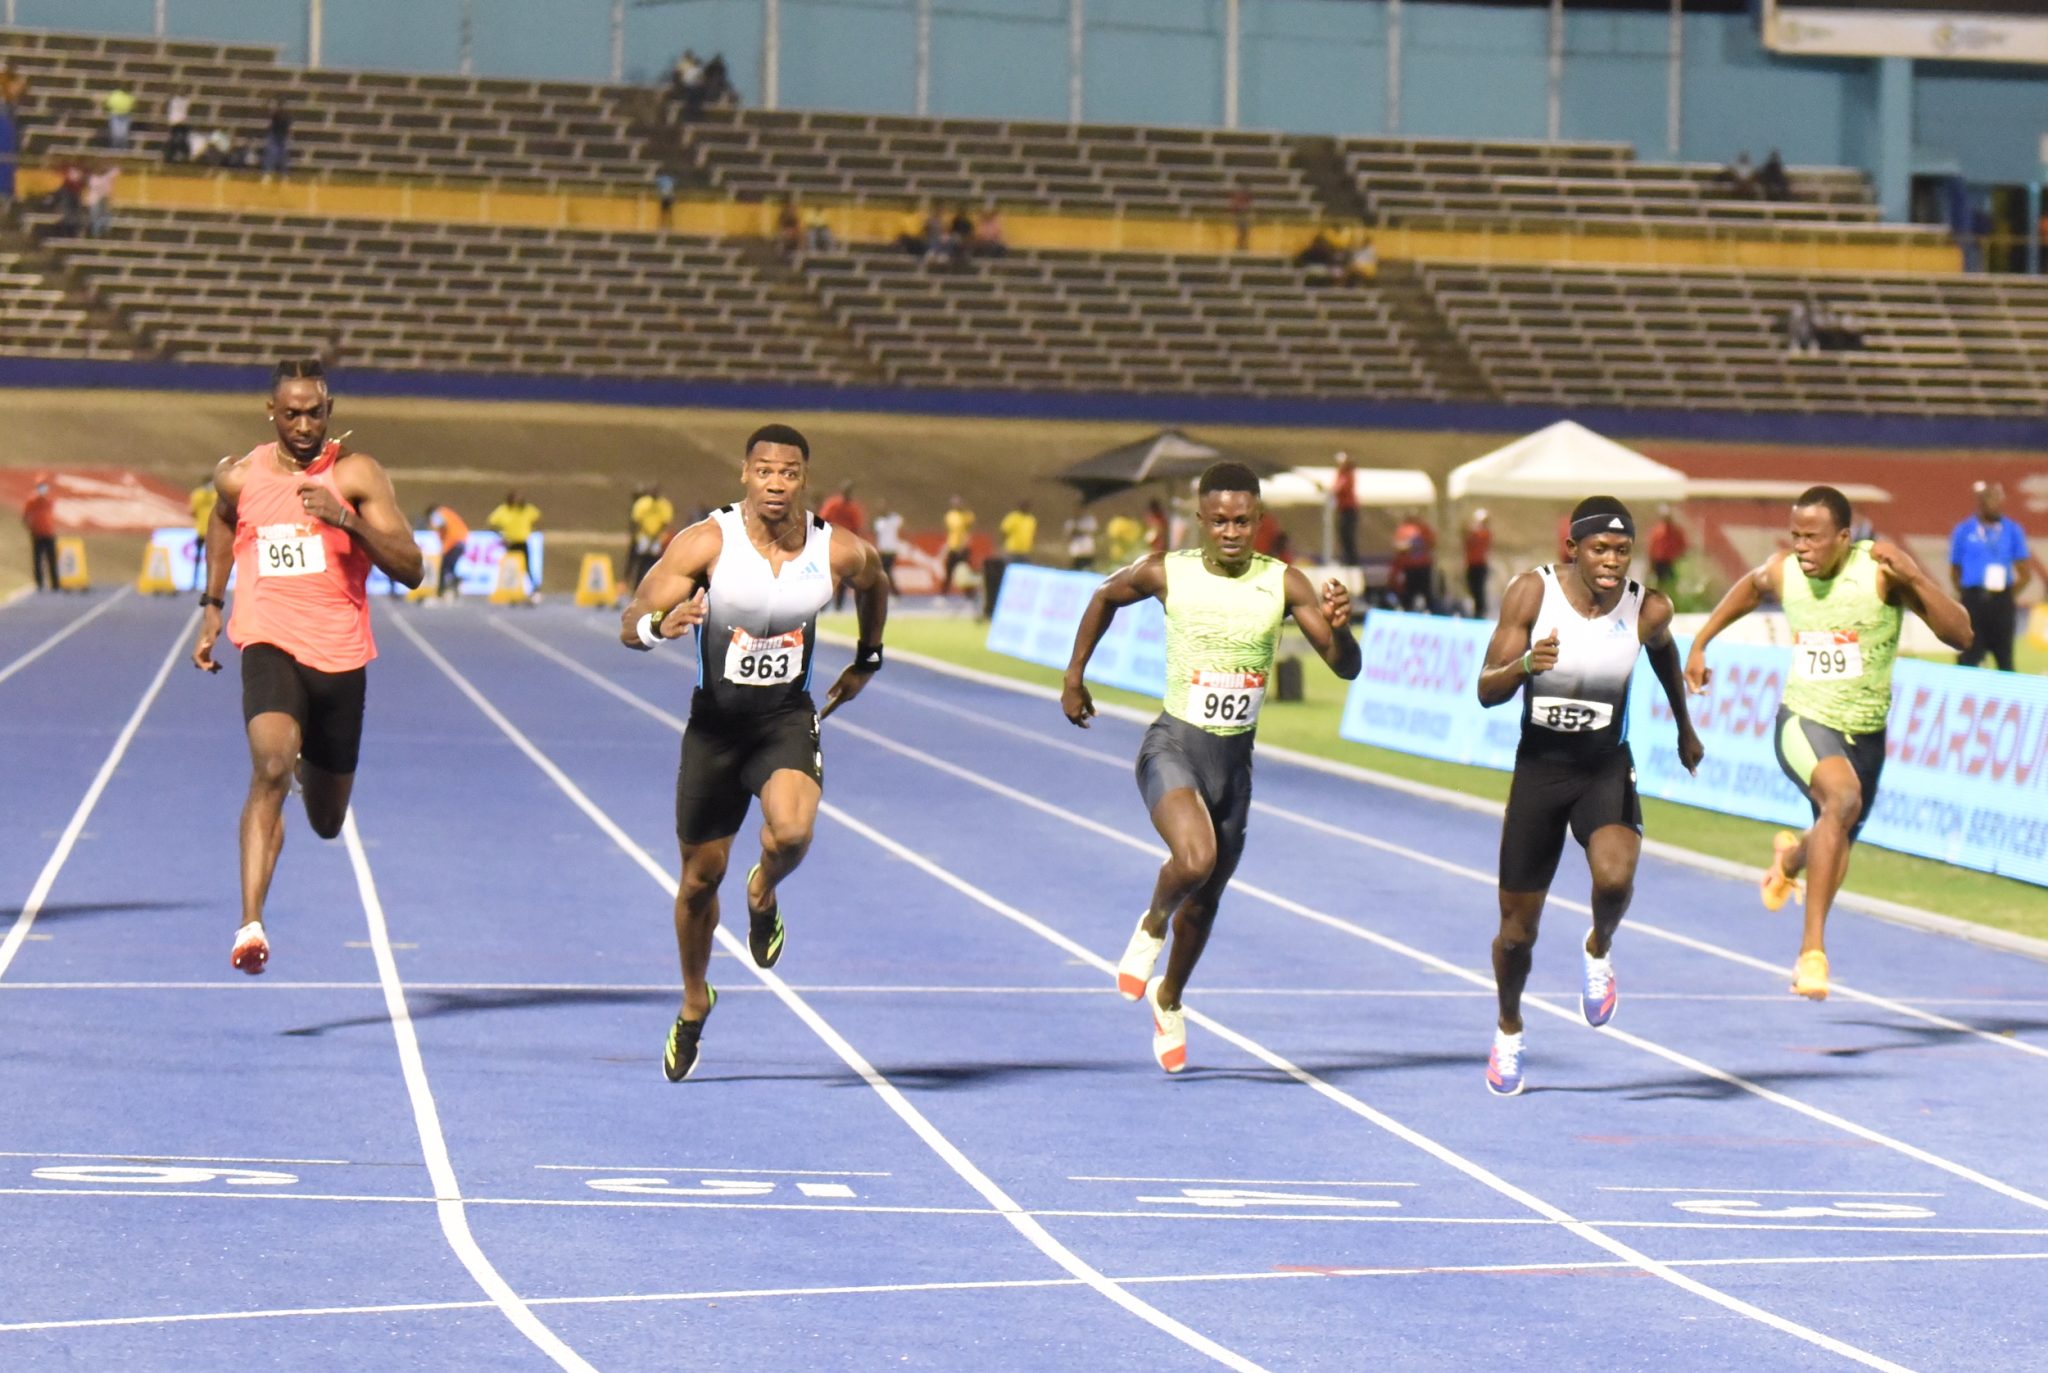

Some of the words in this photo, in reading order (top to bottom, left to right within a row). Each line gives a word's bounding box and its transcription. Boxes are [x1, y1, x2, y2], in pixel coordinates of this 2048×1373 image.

[269, 543, 305, 568] 961
[739, 654, 789, 679] 963
[1807, 650, 1846, 674] 799
[1204, 693, 1250, 720] 962
[1547, 706, 1596, 730] 852
